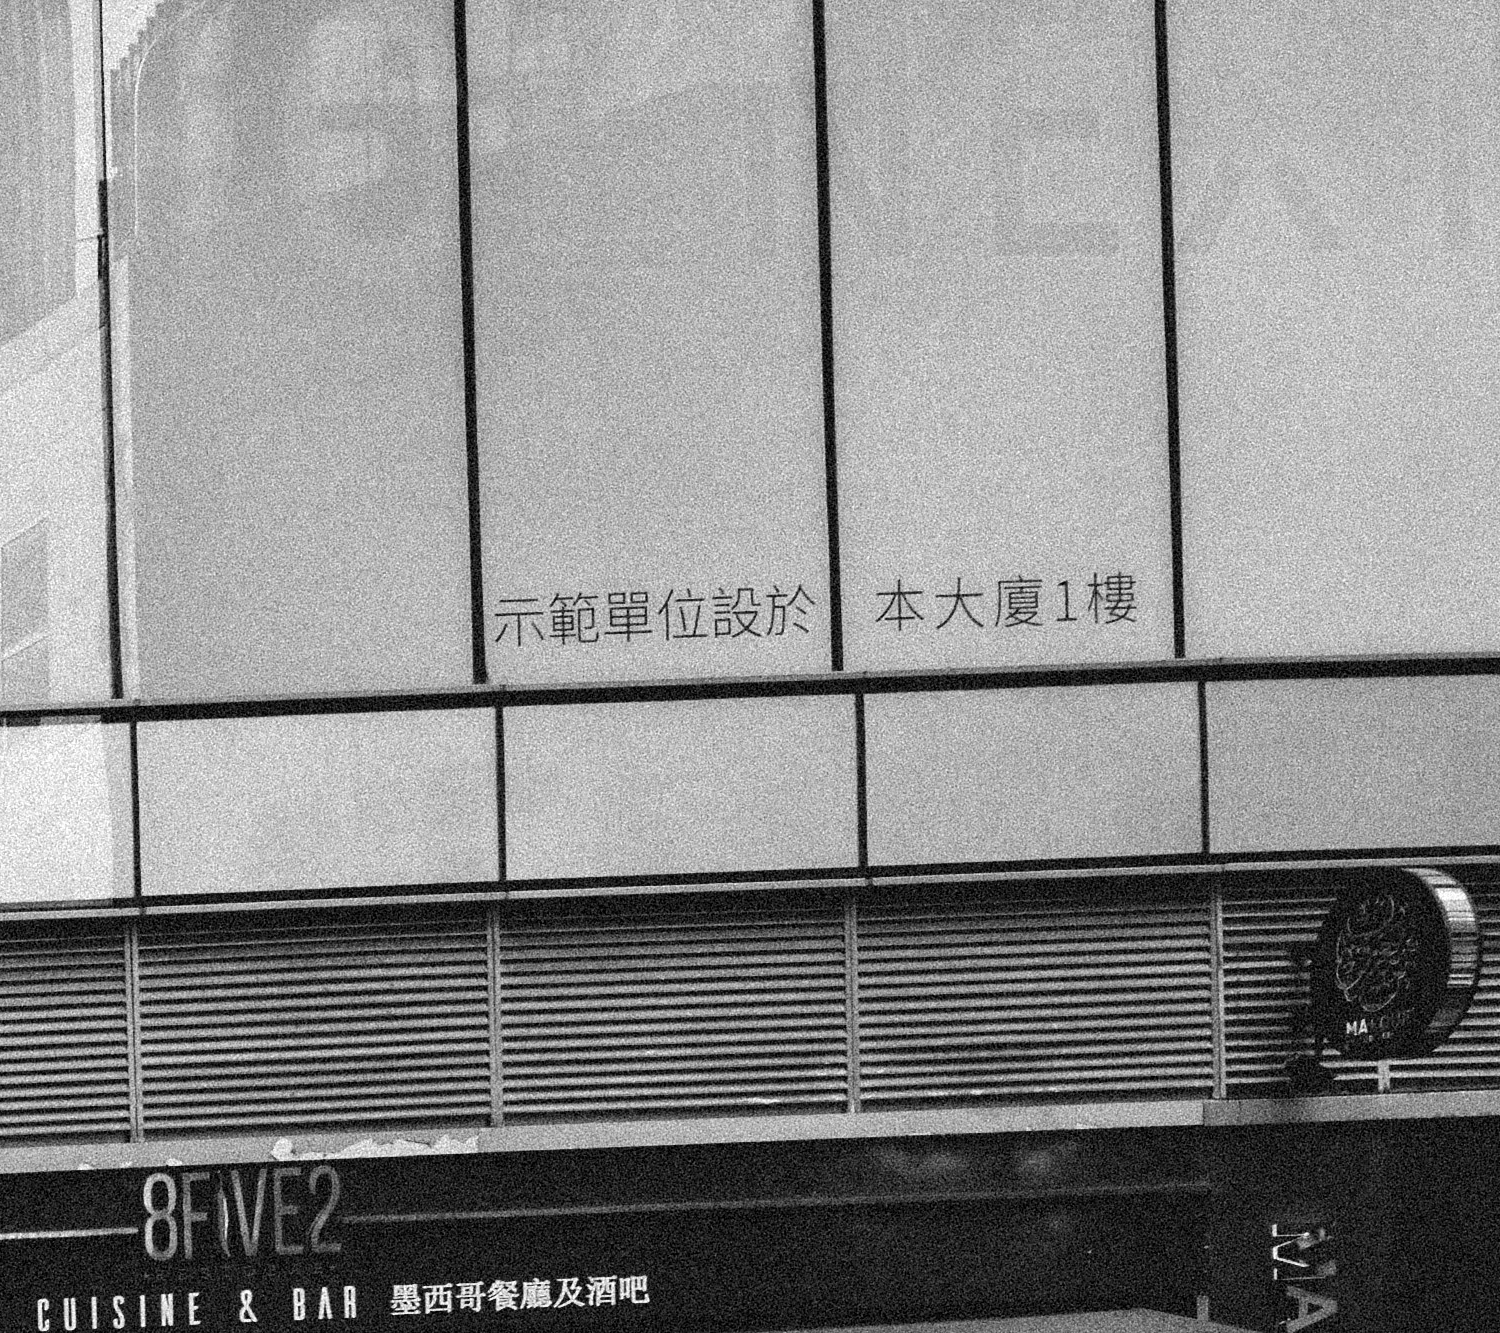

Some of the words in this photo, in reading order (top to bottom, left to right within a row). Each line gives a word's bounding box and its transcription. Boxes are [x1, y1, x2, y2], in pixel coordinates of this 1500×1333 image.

[492, 585, 815, 652] 示範單位設於
[875, 571, 1137, 632] 本大廈1樓
[36, 1291, 201, 1332] CUISINE
[238, 1289, 258, 1323] &
[293, 1285, 357, 1321] BAR
[390, 1276, 650, 1316] 墨西哥餐廳及酒吧
